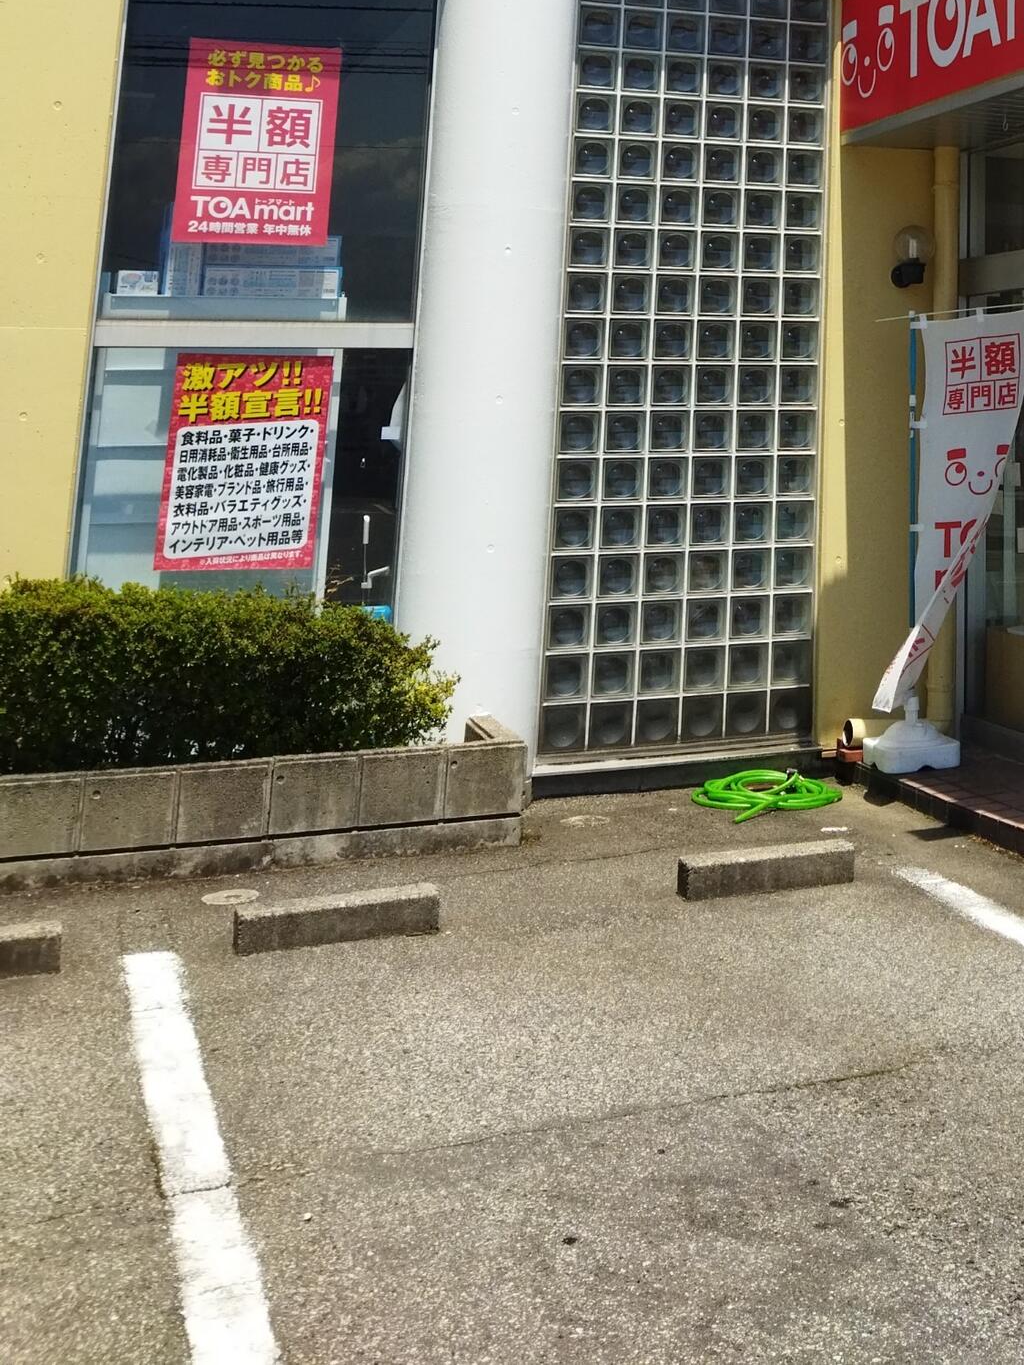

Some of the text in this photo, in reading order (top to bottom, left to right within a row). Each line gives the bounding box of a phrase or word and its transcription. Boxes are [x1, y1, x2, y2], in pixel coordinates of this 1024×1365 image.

[208, 48, 324, 73] 必ず見つかる
[207, 103, 313, 148] 半額
[201, 154, 311, 187] 専門店
[950, 341, 1017, 379] 半額
[947, 382, 1018, 411] 専門店
